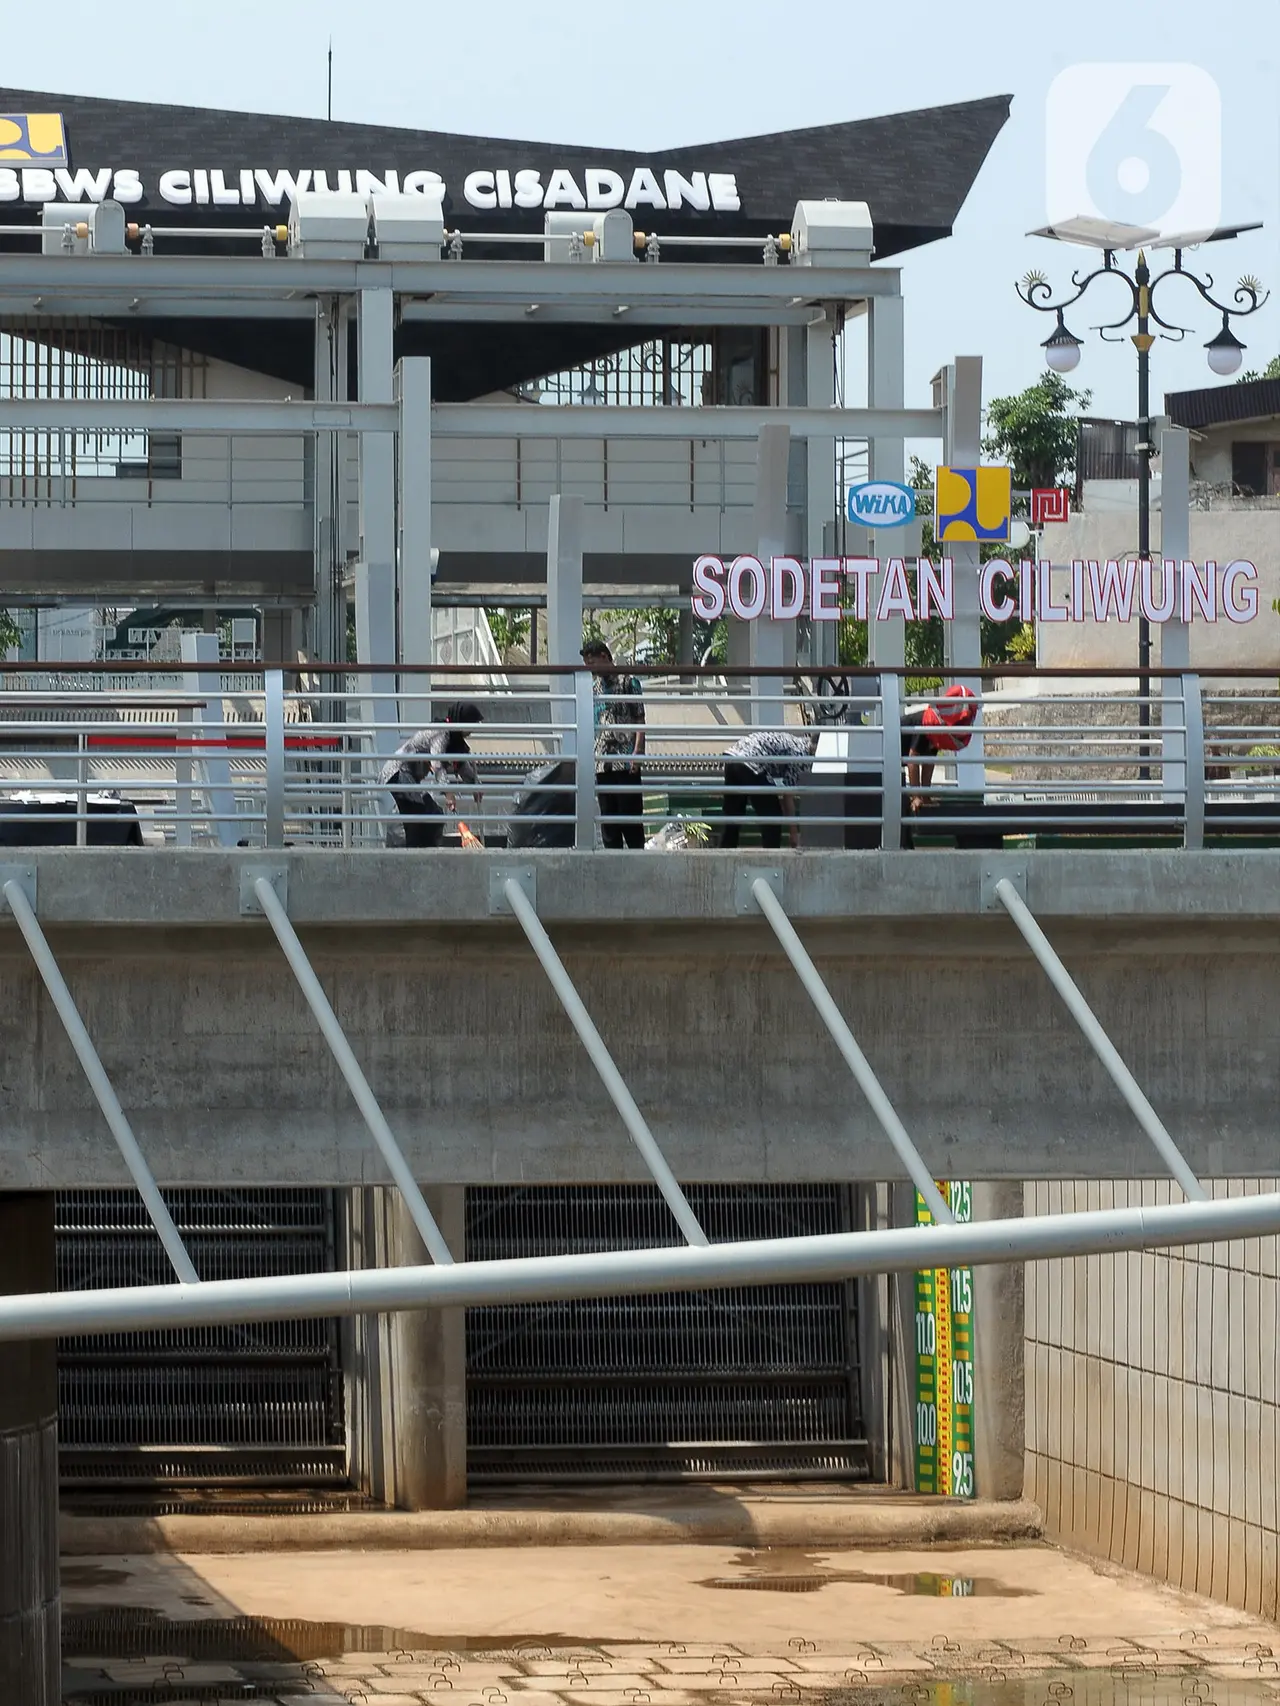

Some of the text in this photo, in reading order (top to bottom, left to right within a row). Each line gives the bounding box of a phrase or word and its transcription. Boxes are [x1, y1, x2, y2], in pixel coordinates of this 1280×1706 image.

[159, 168, 446, 206] CILIWUNG
[463, 167, 741, 211] CISADANE
[691, 553, 1260, 624] SODETAN CILIWUNG
[951, 1268, 972, 1314] 11.5
[915, 1312, 936, 1356] 11.0
[952, 1359, 973, 1405] 10.5
[916, 1402, 937, 1446] 10.0
[952, 1451, 973, 1497] 9.5
